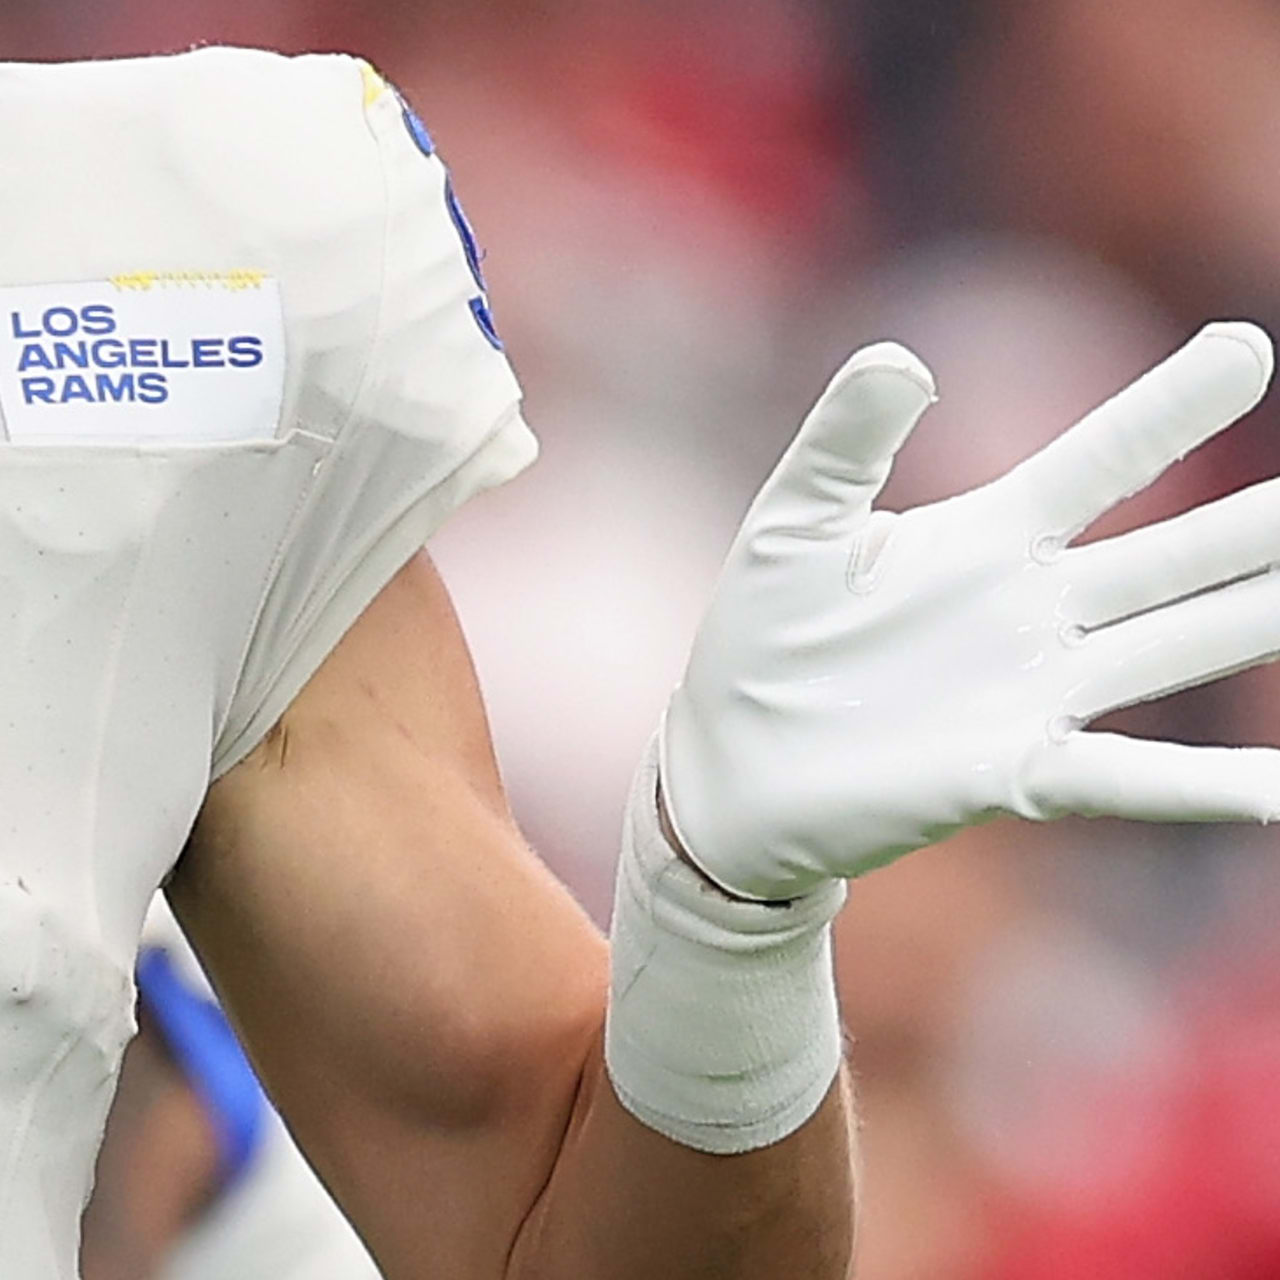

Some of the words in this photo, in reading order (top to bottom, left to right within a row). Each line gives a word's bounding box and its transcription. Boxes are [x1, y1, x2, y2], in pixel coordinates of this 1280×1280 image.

[11, 305, 117, 339] LOS
[17, 336, 264, 372] ANGELES
[20, 372, 169, 405] RAMS
